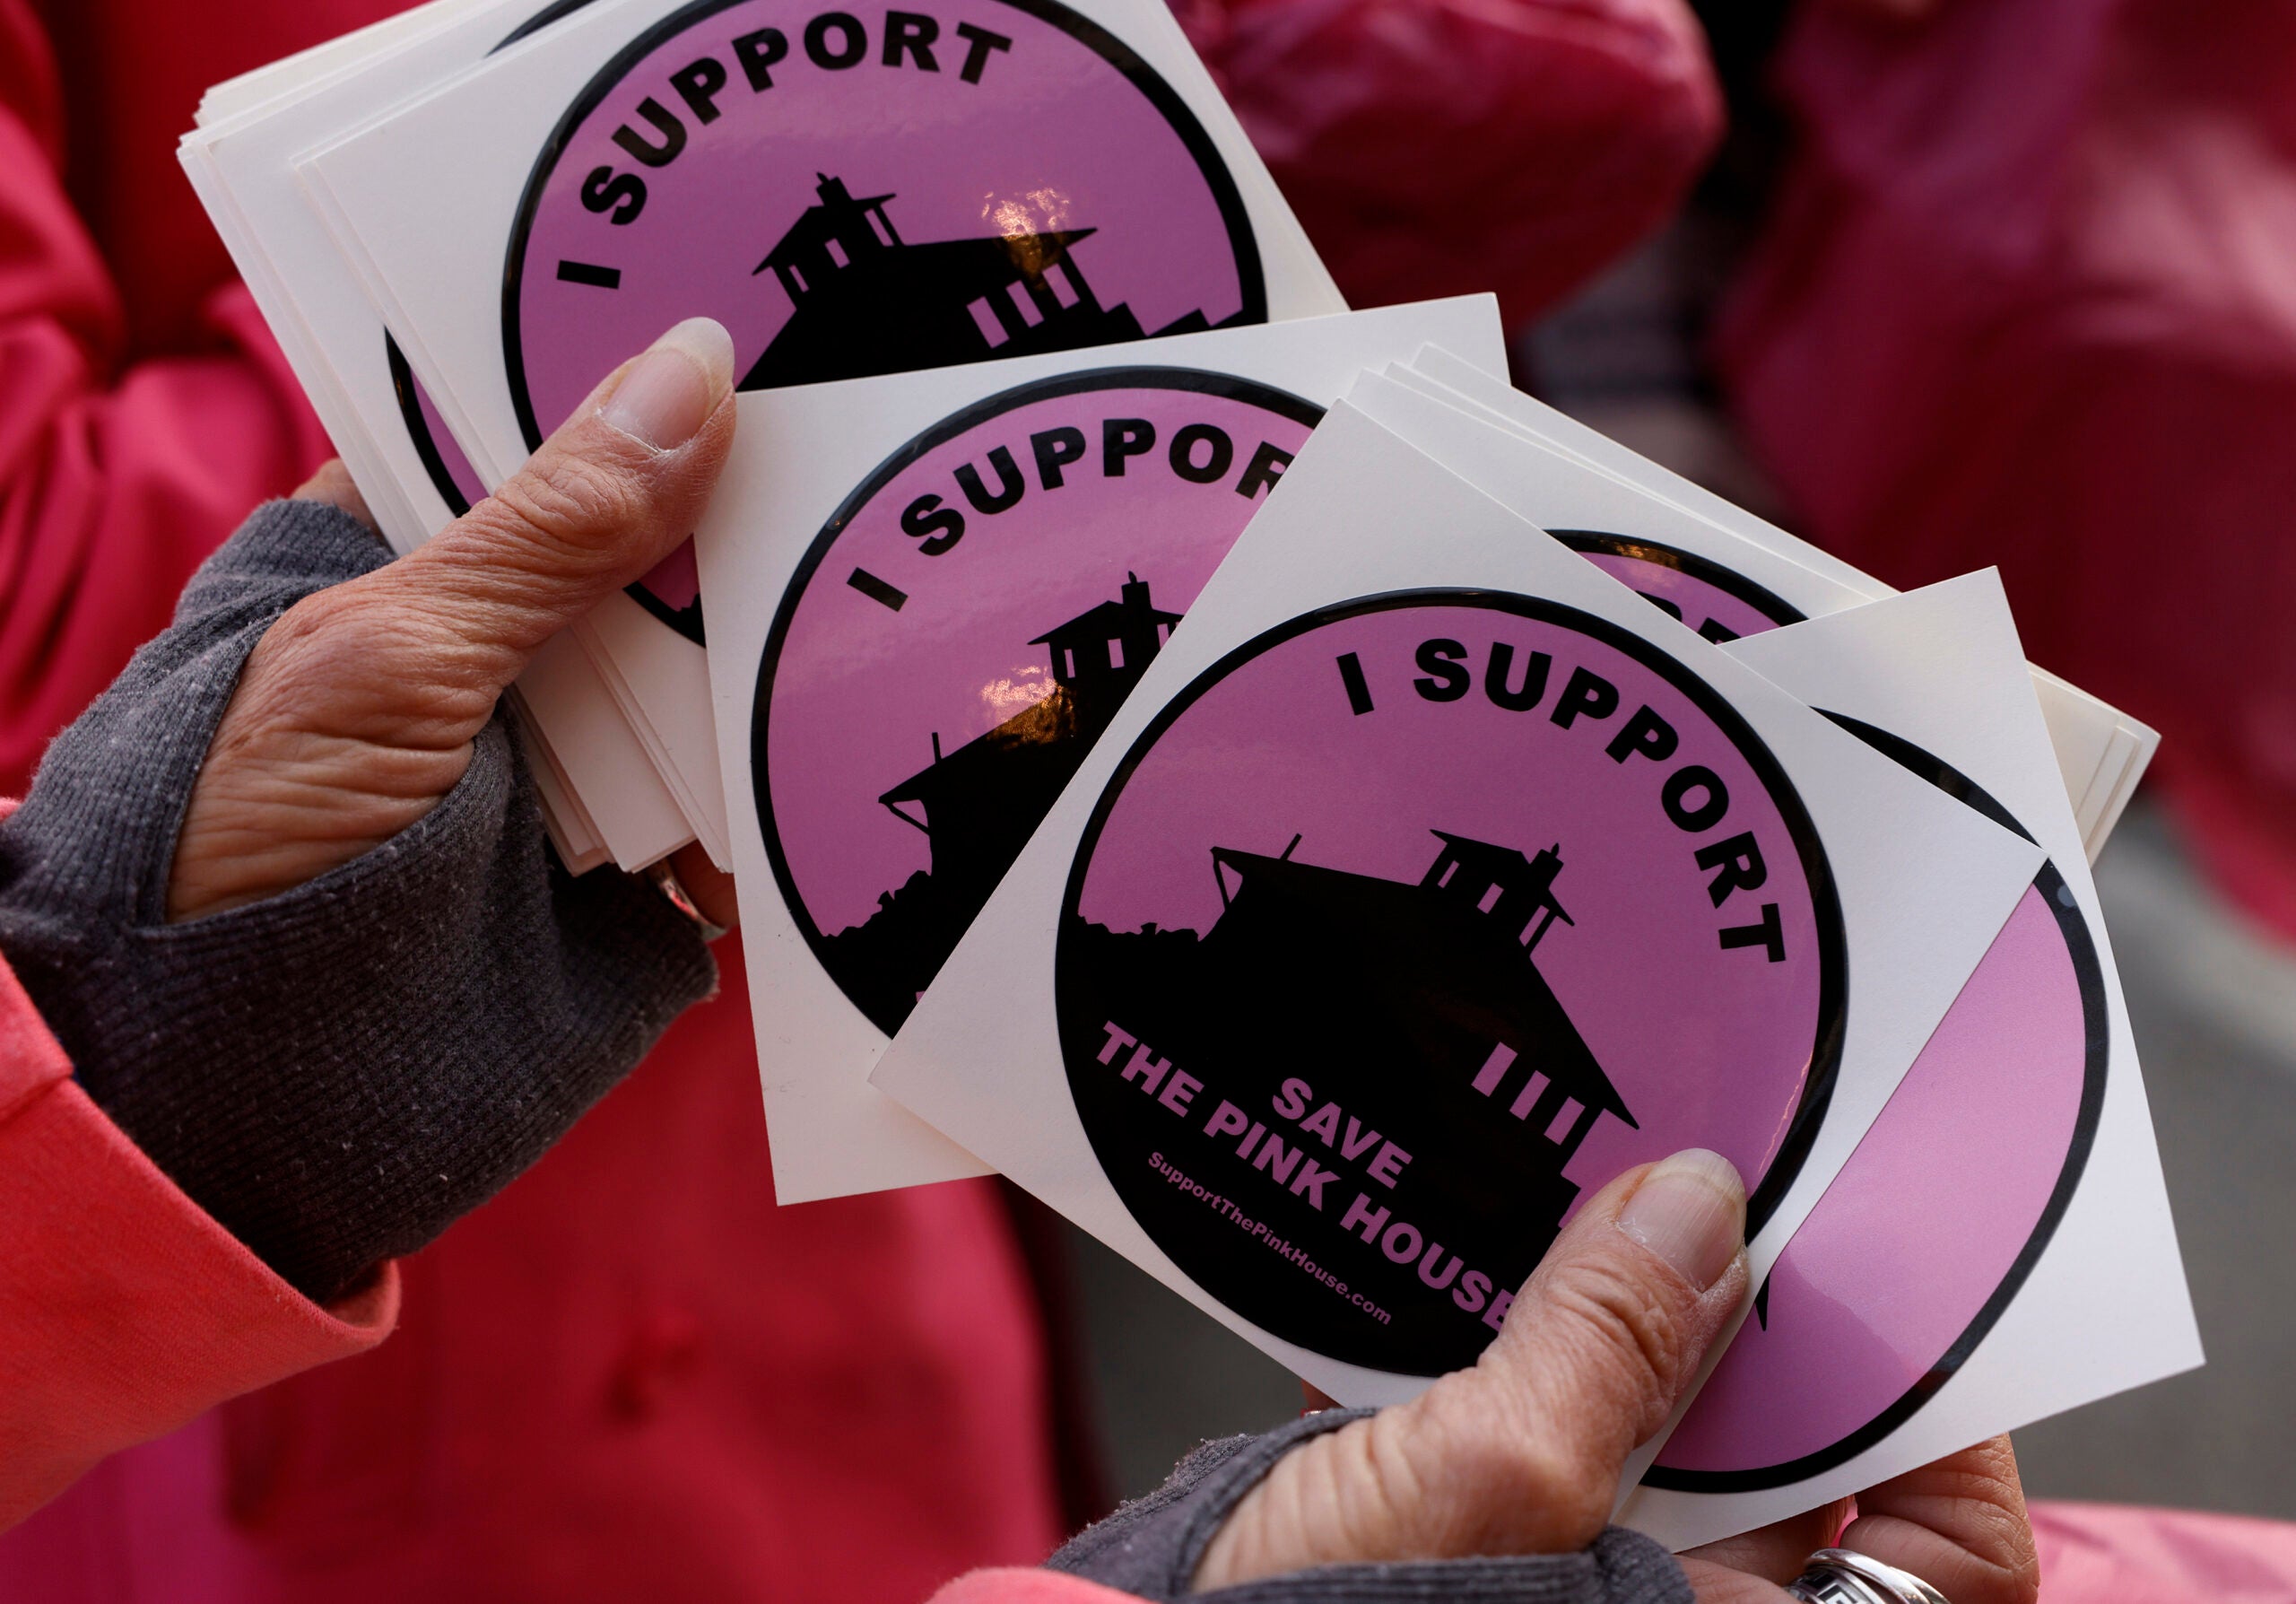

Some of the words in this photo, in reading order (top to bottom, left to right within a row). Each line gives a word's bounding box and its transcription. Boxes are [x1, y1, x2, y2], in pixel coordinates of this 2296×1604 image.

[580, 10, 1013, 226] SUPPORT
[556, 259, 621, 290] I
[846, 567, 909, 612] I
[900, 418, 1295, 556] SUPPOR
[1336, 651, 1375, 716] I
[1413, 638, 1786, 963] SUPPORT
[1096, 1020, 1205, 1118] THE
[1203, 1099, 1341, 1211] PINK
[1272, 1077, 1413, 1190] SAVE
[1148, 1151, 1391, 1325] SupportThePinkHouse.com
